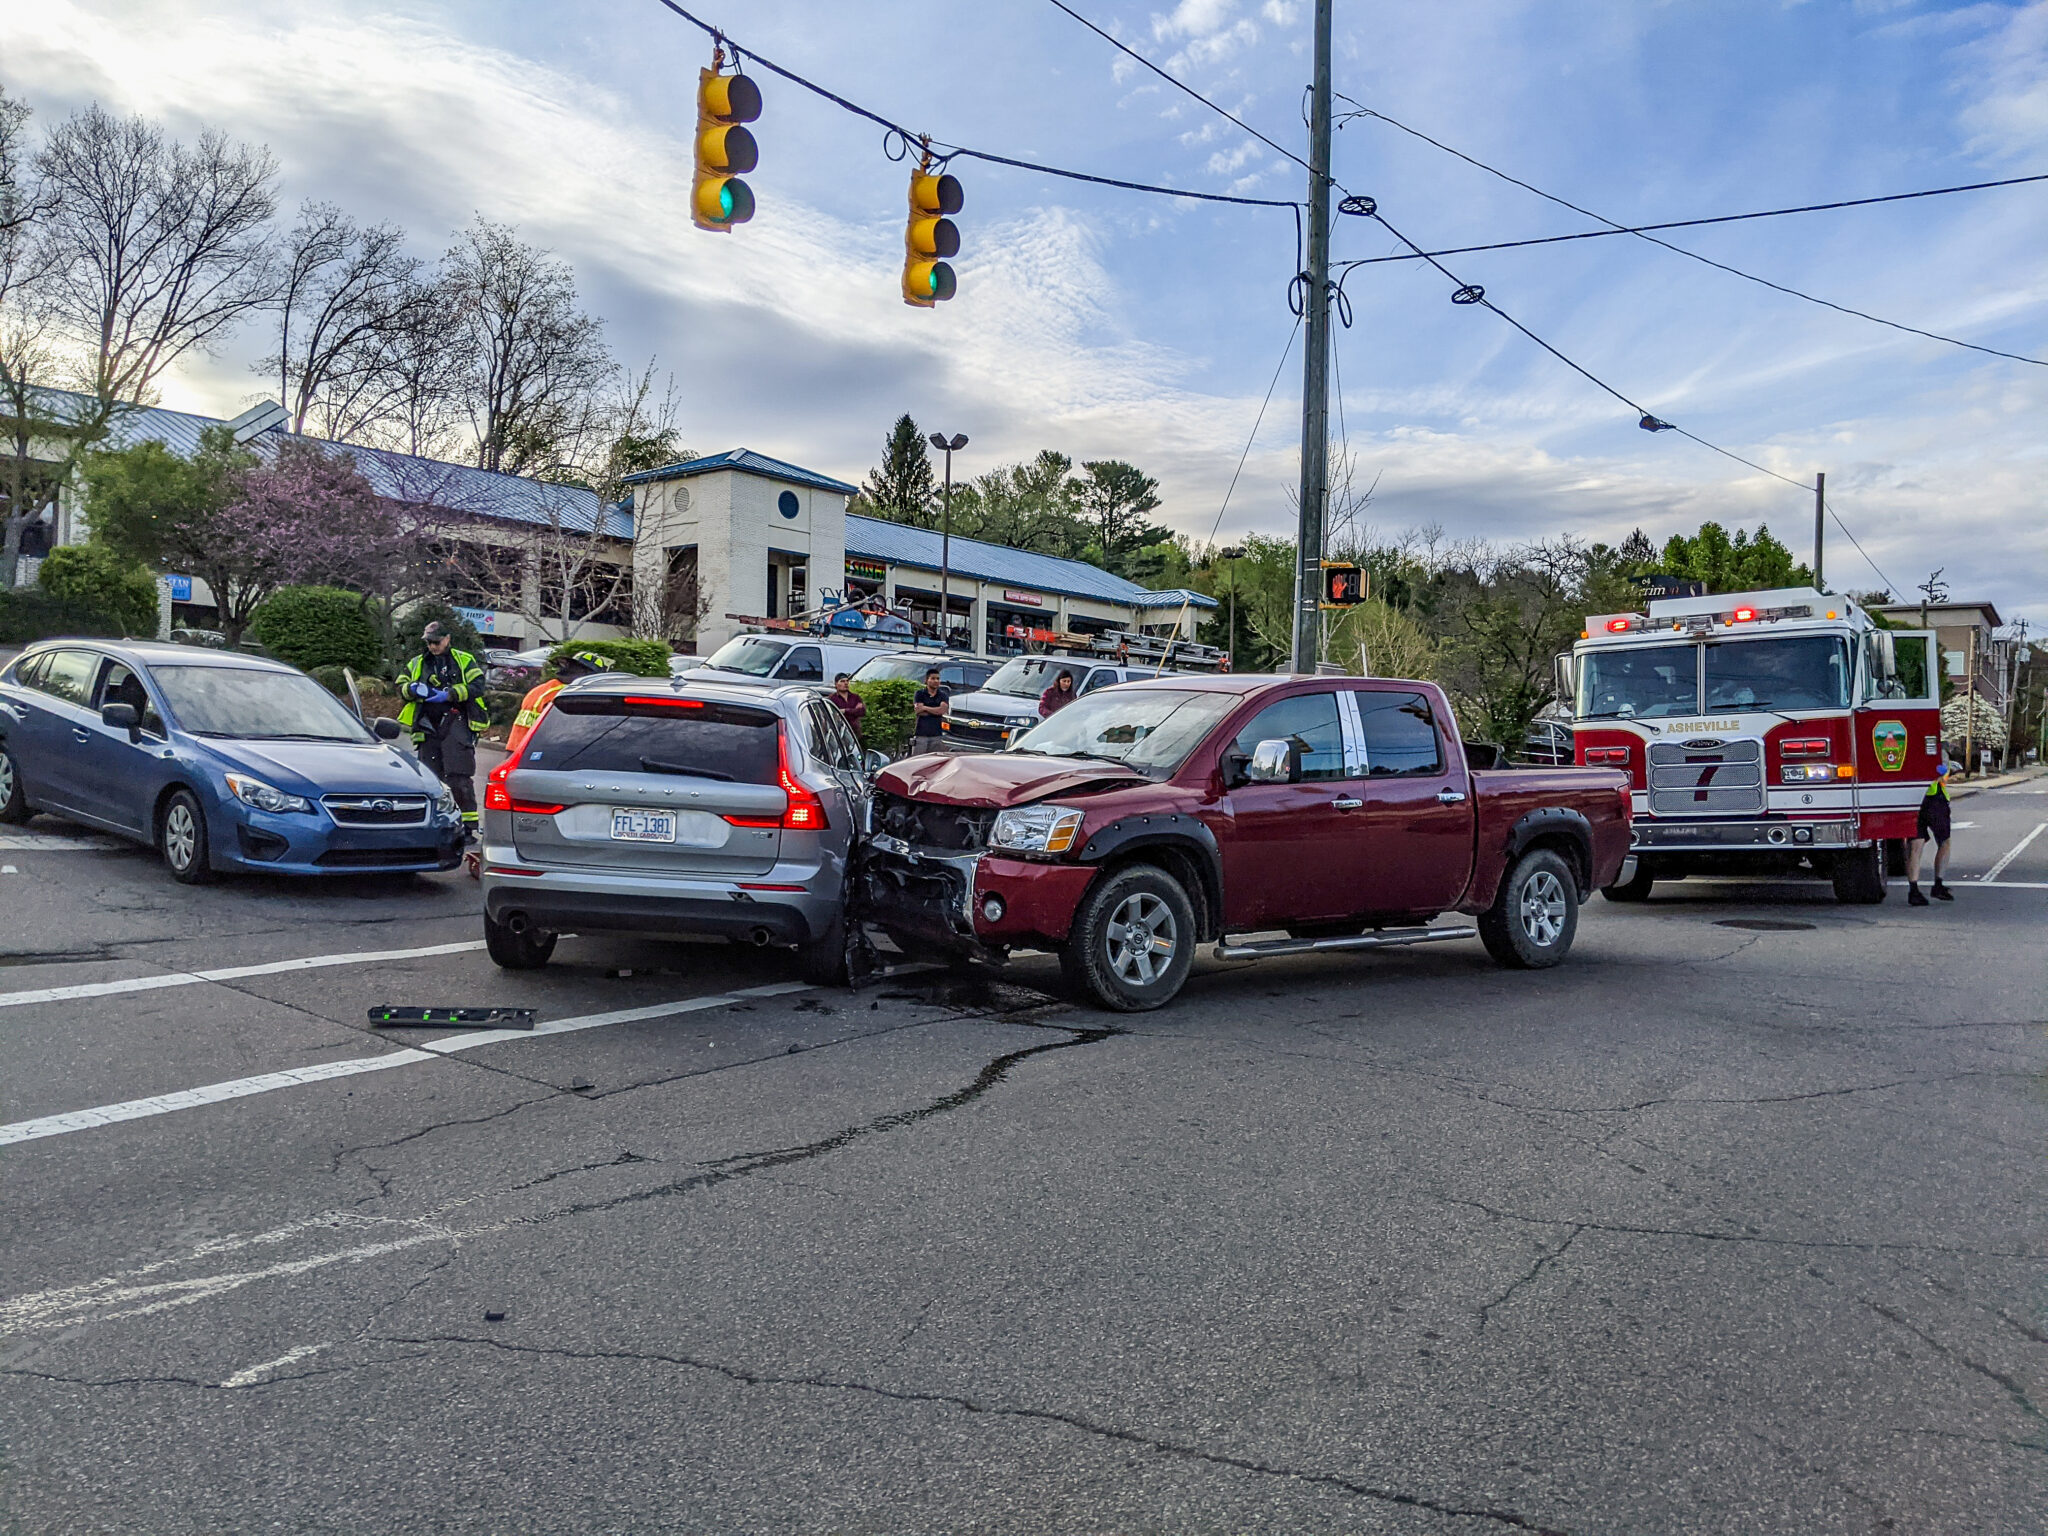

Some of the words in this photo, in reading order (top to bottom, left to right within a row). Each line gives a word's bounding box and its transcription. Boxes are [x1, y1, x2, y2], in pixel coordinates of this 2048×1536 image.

[1667, 720, 1739, 733] ASHEVILLE
[1685, 755, 1723, 801] 7
[615, 815, 671, 834] FFL-1381
